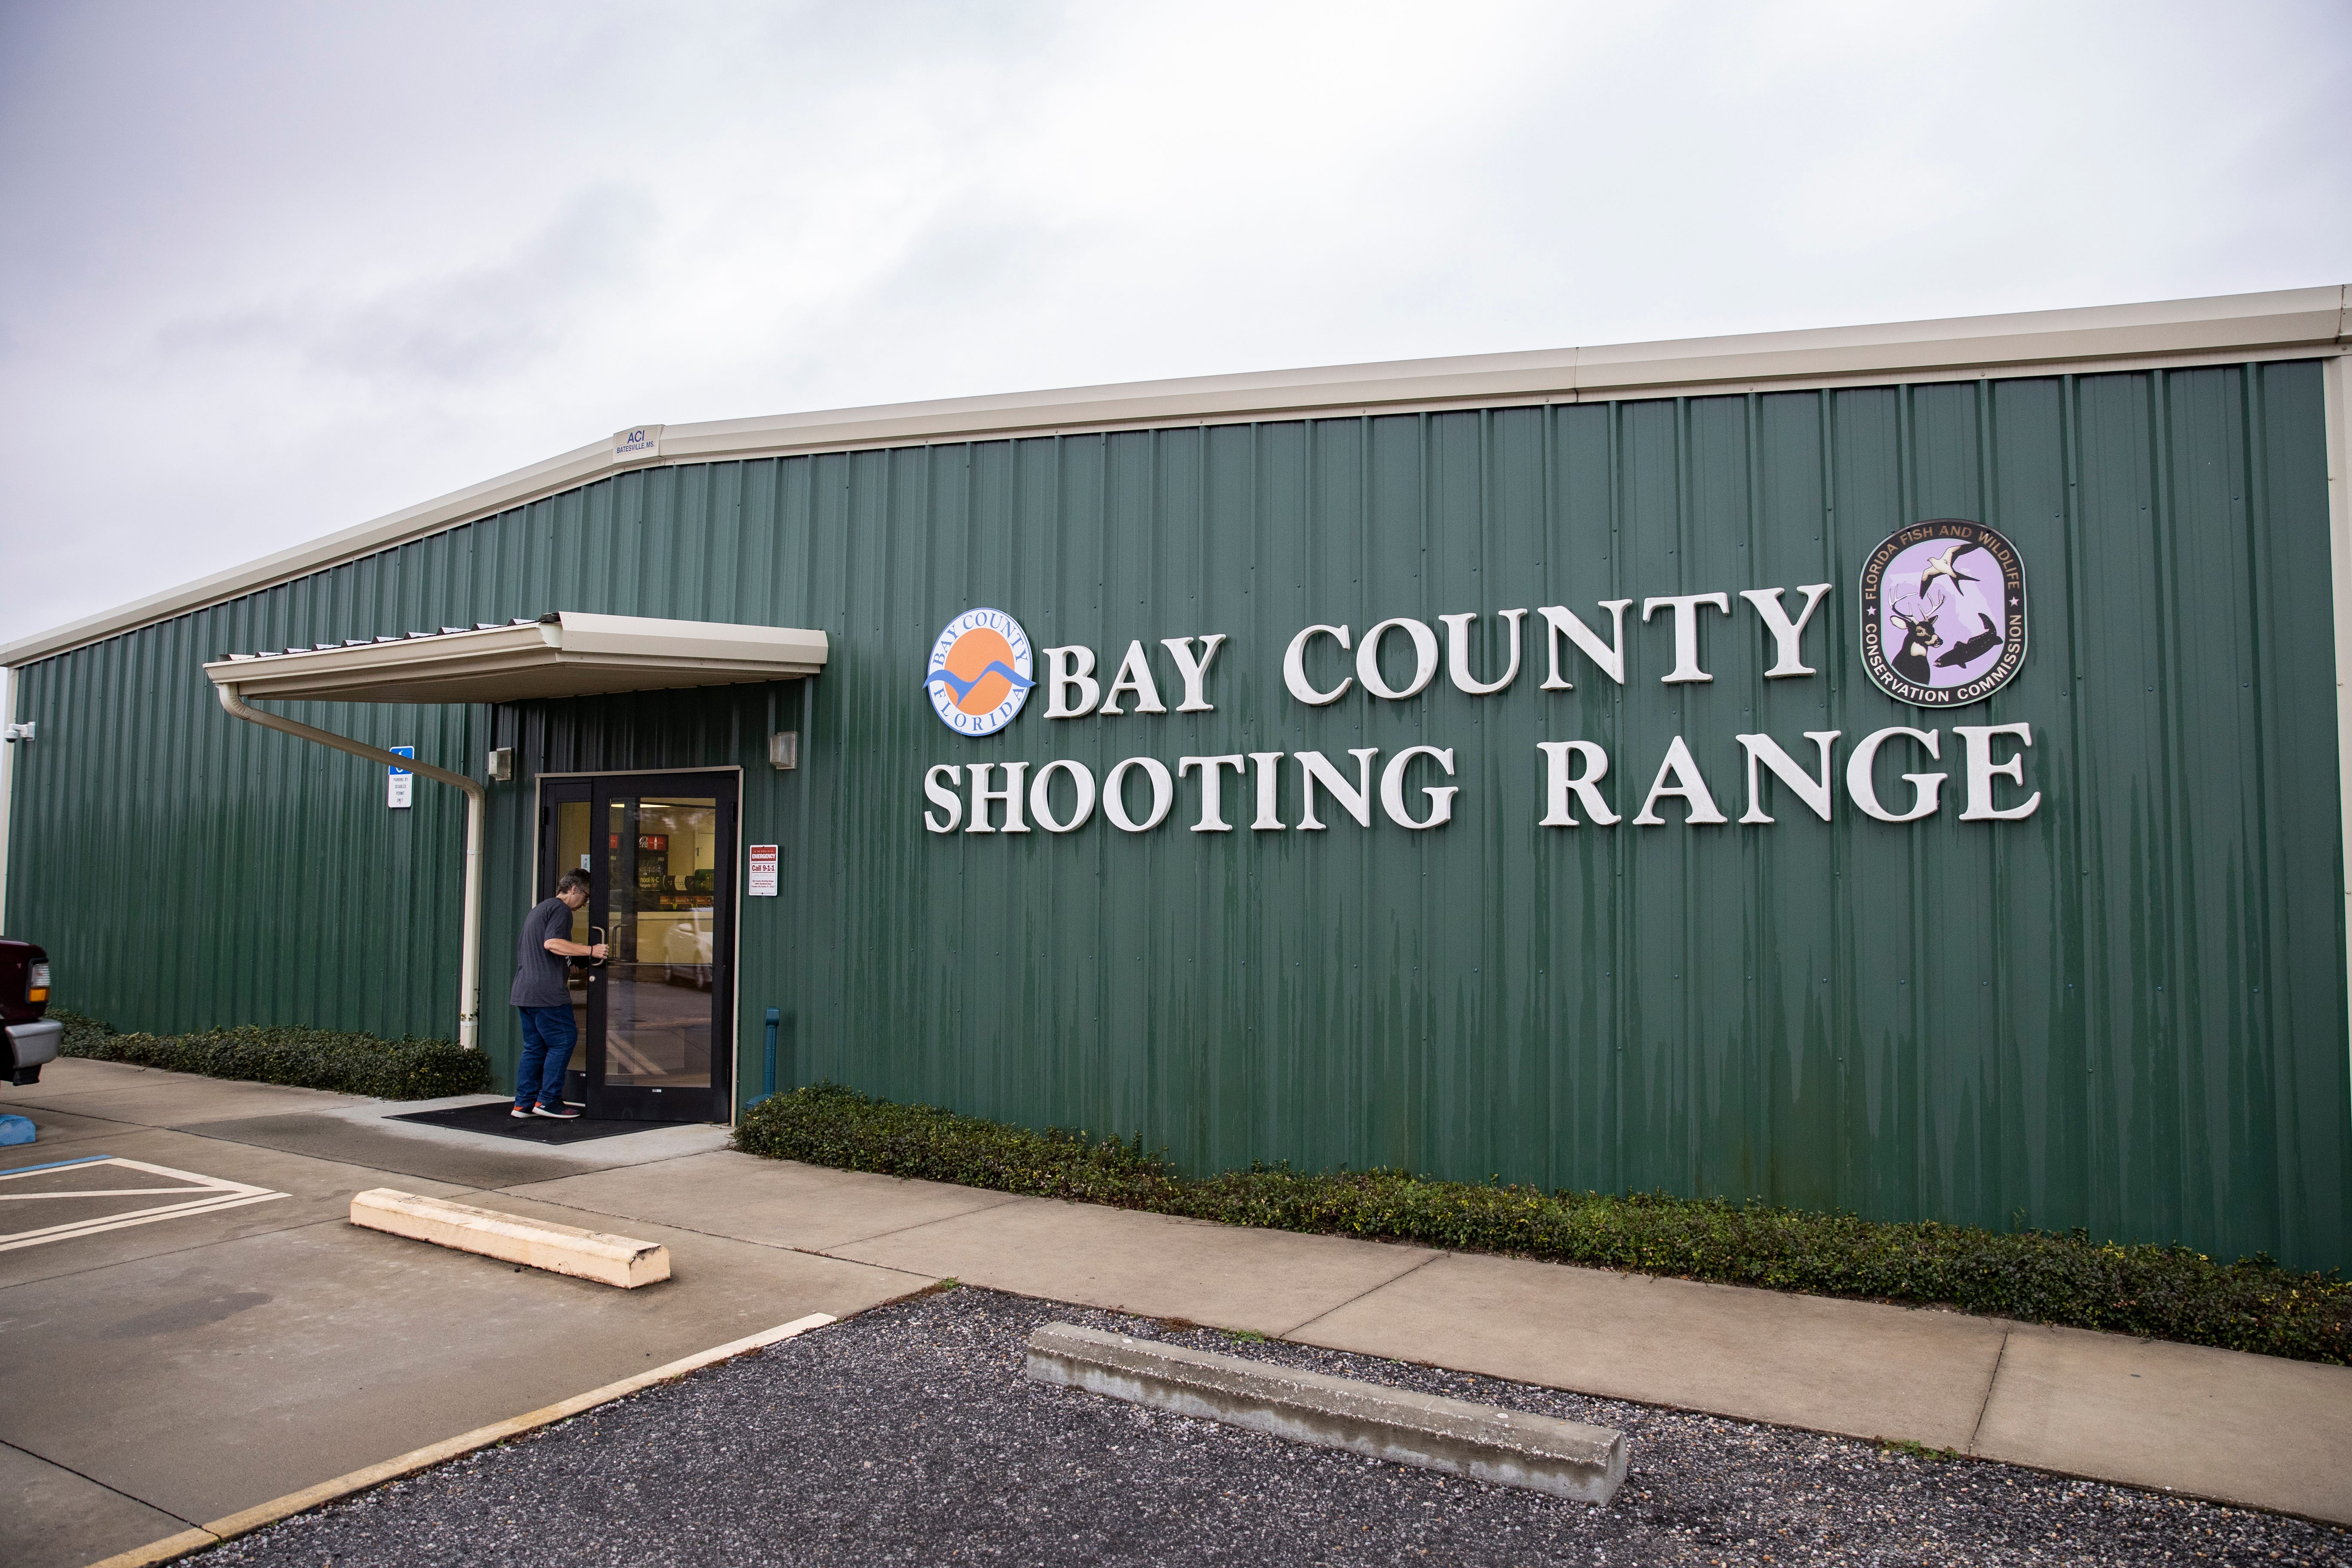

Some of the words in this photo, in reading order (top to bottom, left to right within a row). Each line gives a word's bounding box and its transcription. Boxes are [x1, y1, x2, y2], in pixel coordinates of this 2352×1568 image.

[617, 442, 646, 453] BATESVILLE,
[627, 430, 645, 444] ACI
[1865, 543, 1898, 600] FLORIDA
[1899, 526, 1933, 545] FISH
[1939, 525, 1972, 538] AND
[1978, 531, 2019, 590] WILDLIFE
[932, 625, 959, 666] BAY
[963, 612, 1028, 662] COUNTY
[1042, 633, 1227, 720] BAY
[1283, 583, 1833, 706] COUNTY
[1865, 623, 1949, 702] CONSERVATION
[1957, 614, 2022, 700] COMMISSION
[934, 686, 1026, 731] FLORIDA
[924, 745, 1459, 833] SHOOTING
[1536, 722, 2041, 827] RANGE
